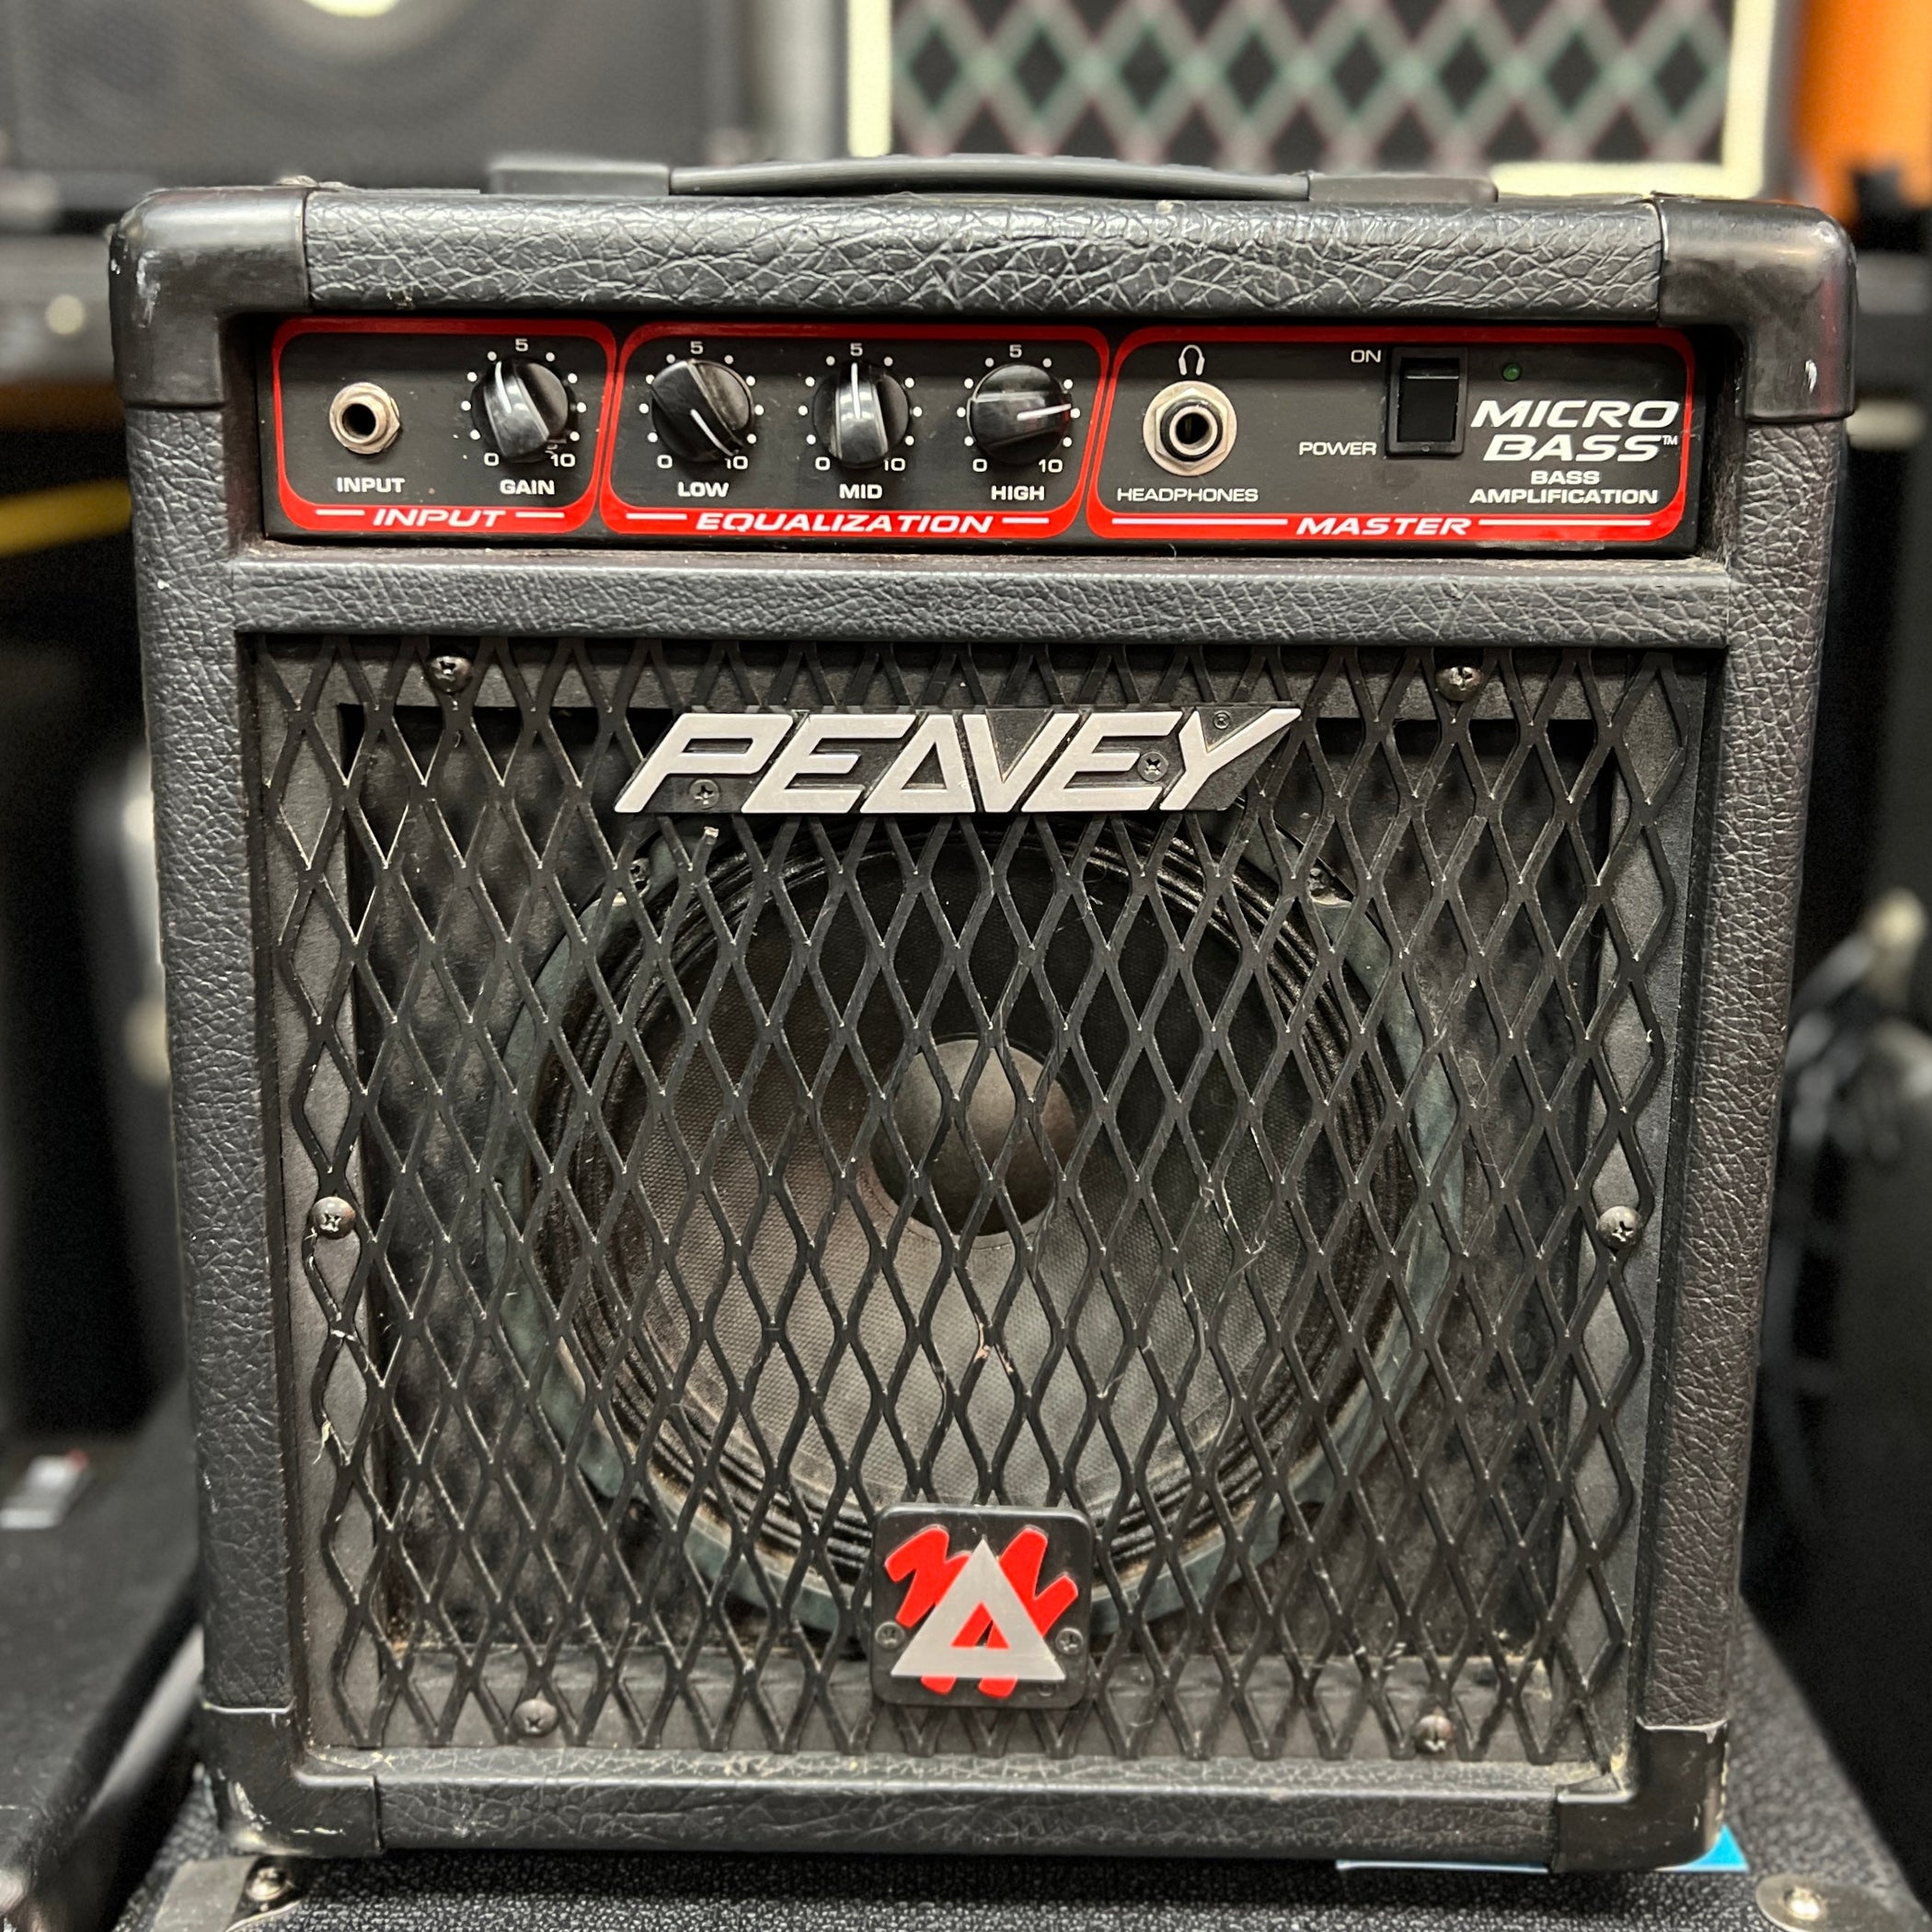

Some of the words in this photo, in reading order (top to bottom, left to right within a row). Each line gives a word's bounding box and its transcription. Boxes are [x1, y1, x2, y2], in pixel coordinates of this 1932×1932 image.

[515, 339, 528, 351] 5
[691, 341, 703, 354] 5
[850, 343, 863, 356] 5
[1009, 345, 1022, 358] 5
[1351, 350, 1381, 363] ON
[1470, 400, 1680, 428] MICRO
[1299, 442, 1377, 456] POWER
[484, 453, 500, 467] 0
[550, 453, 576, 468] 10
[657, 454, 673, 469] 0
[724, 455, 749, 470] 10
[814, 456, 830, 471] 0
[883, 457, 906, 472] 10
[972, 458, 987, 473] 0
[1039, 459, 1063, 474] 10
[337, 477, 405, 493] INPUT
[1531, 470, 1600, 485] BASS
[500, 479, 555, 496] GAIN
[678, 482, 729, 498] LOW
[839, 484, 882, 499] MID
[991, 486, 1045, 500] HIGH
[1117, 488, 1259, 502] HEADPHONES
[1469, 489, 1658, 504] AMPLIFICATION
[373, 508, 506, 527] INPUT
[696, 512, 993, 534] EQUALIZATION
[1295, 517, 1472, 535] MASTER
[615, 707, 1301, 813] PEAVEY
